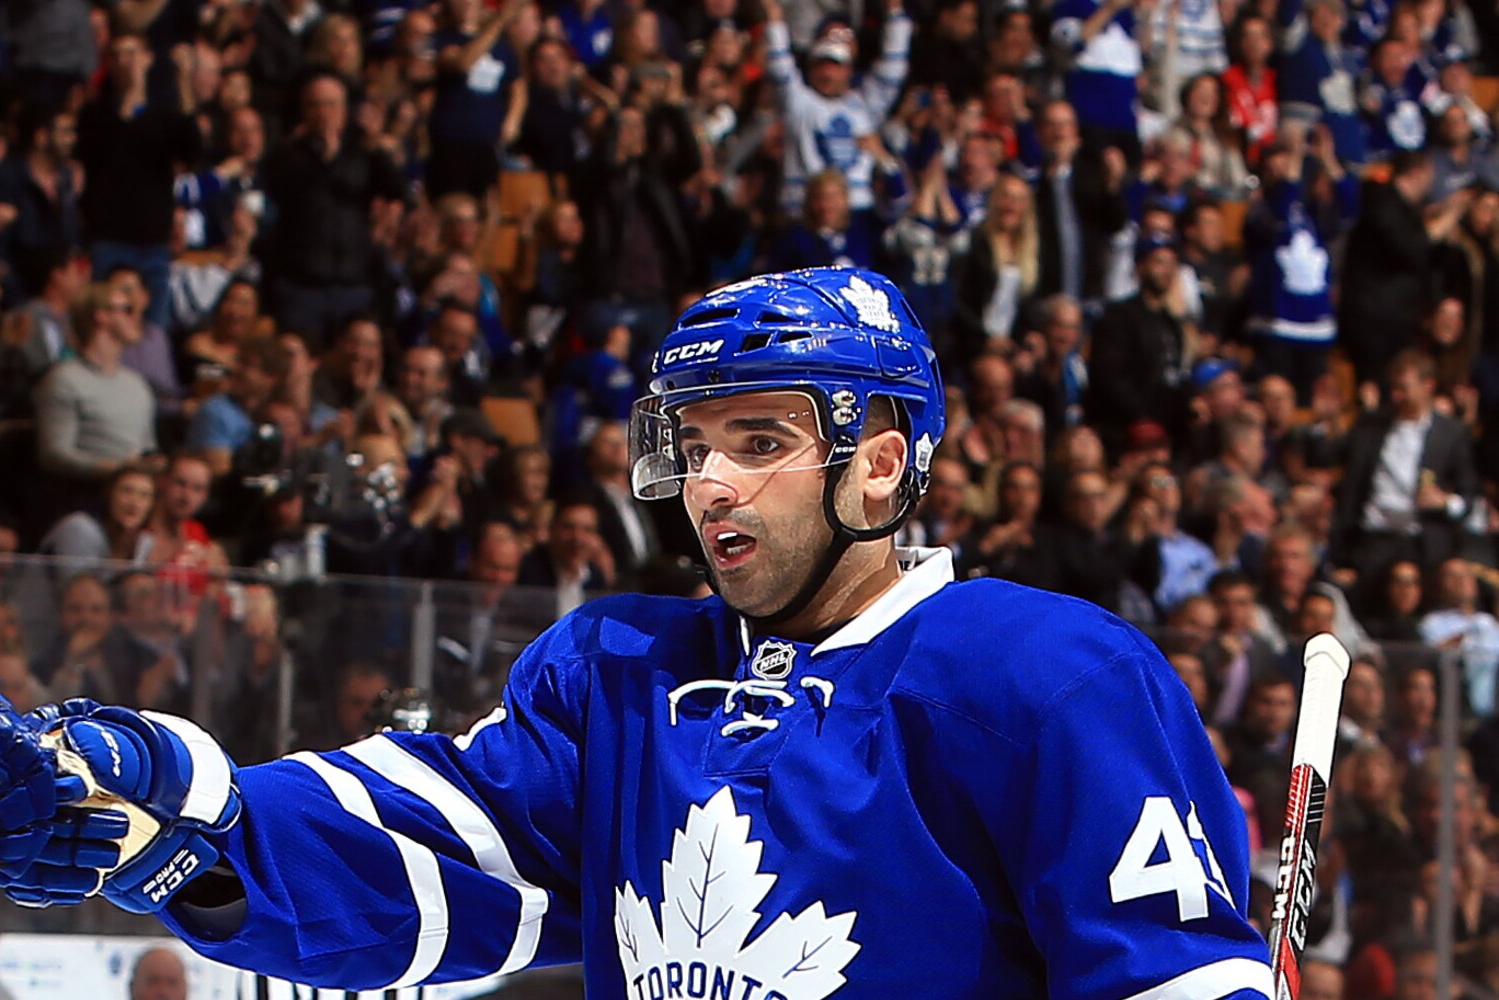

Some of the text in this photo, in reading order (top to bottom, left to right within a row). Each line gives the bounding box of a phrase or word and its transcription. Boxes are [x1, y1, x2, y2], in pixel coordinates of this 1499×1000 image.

[663, 339, 724, 365] CCM
[152, 853, 200, 903] CCM
[1291, 838, 1317, 951] CCM
